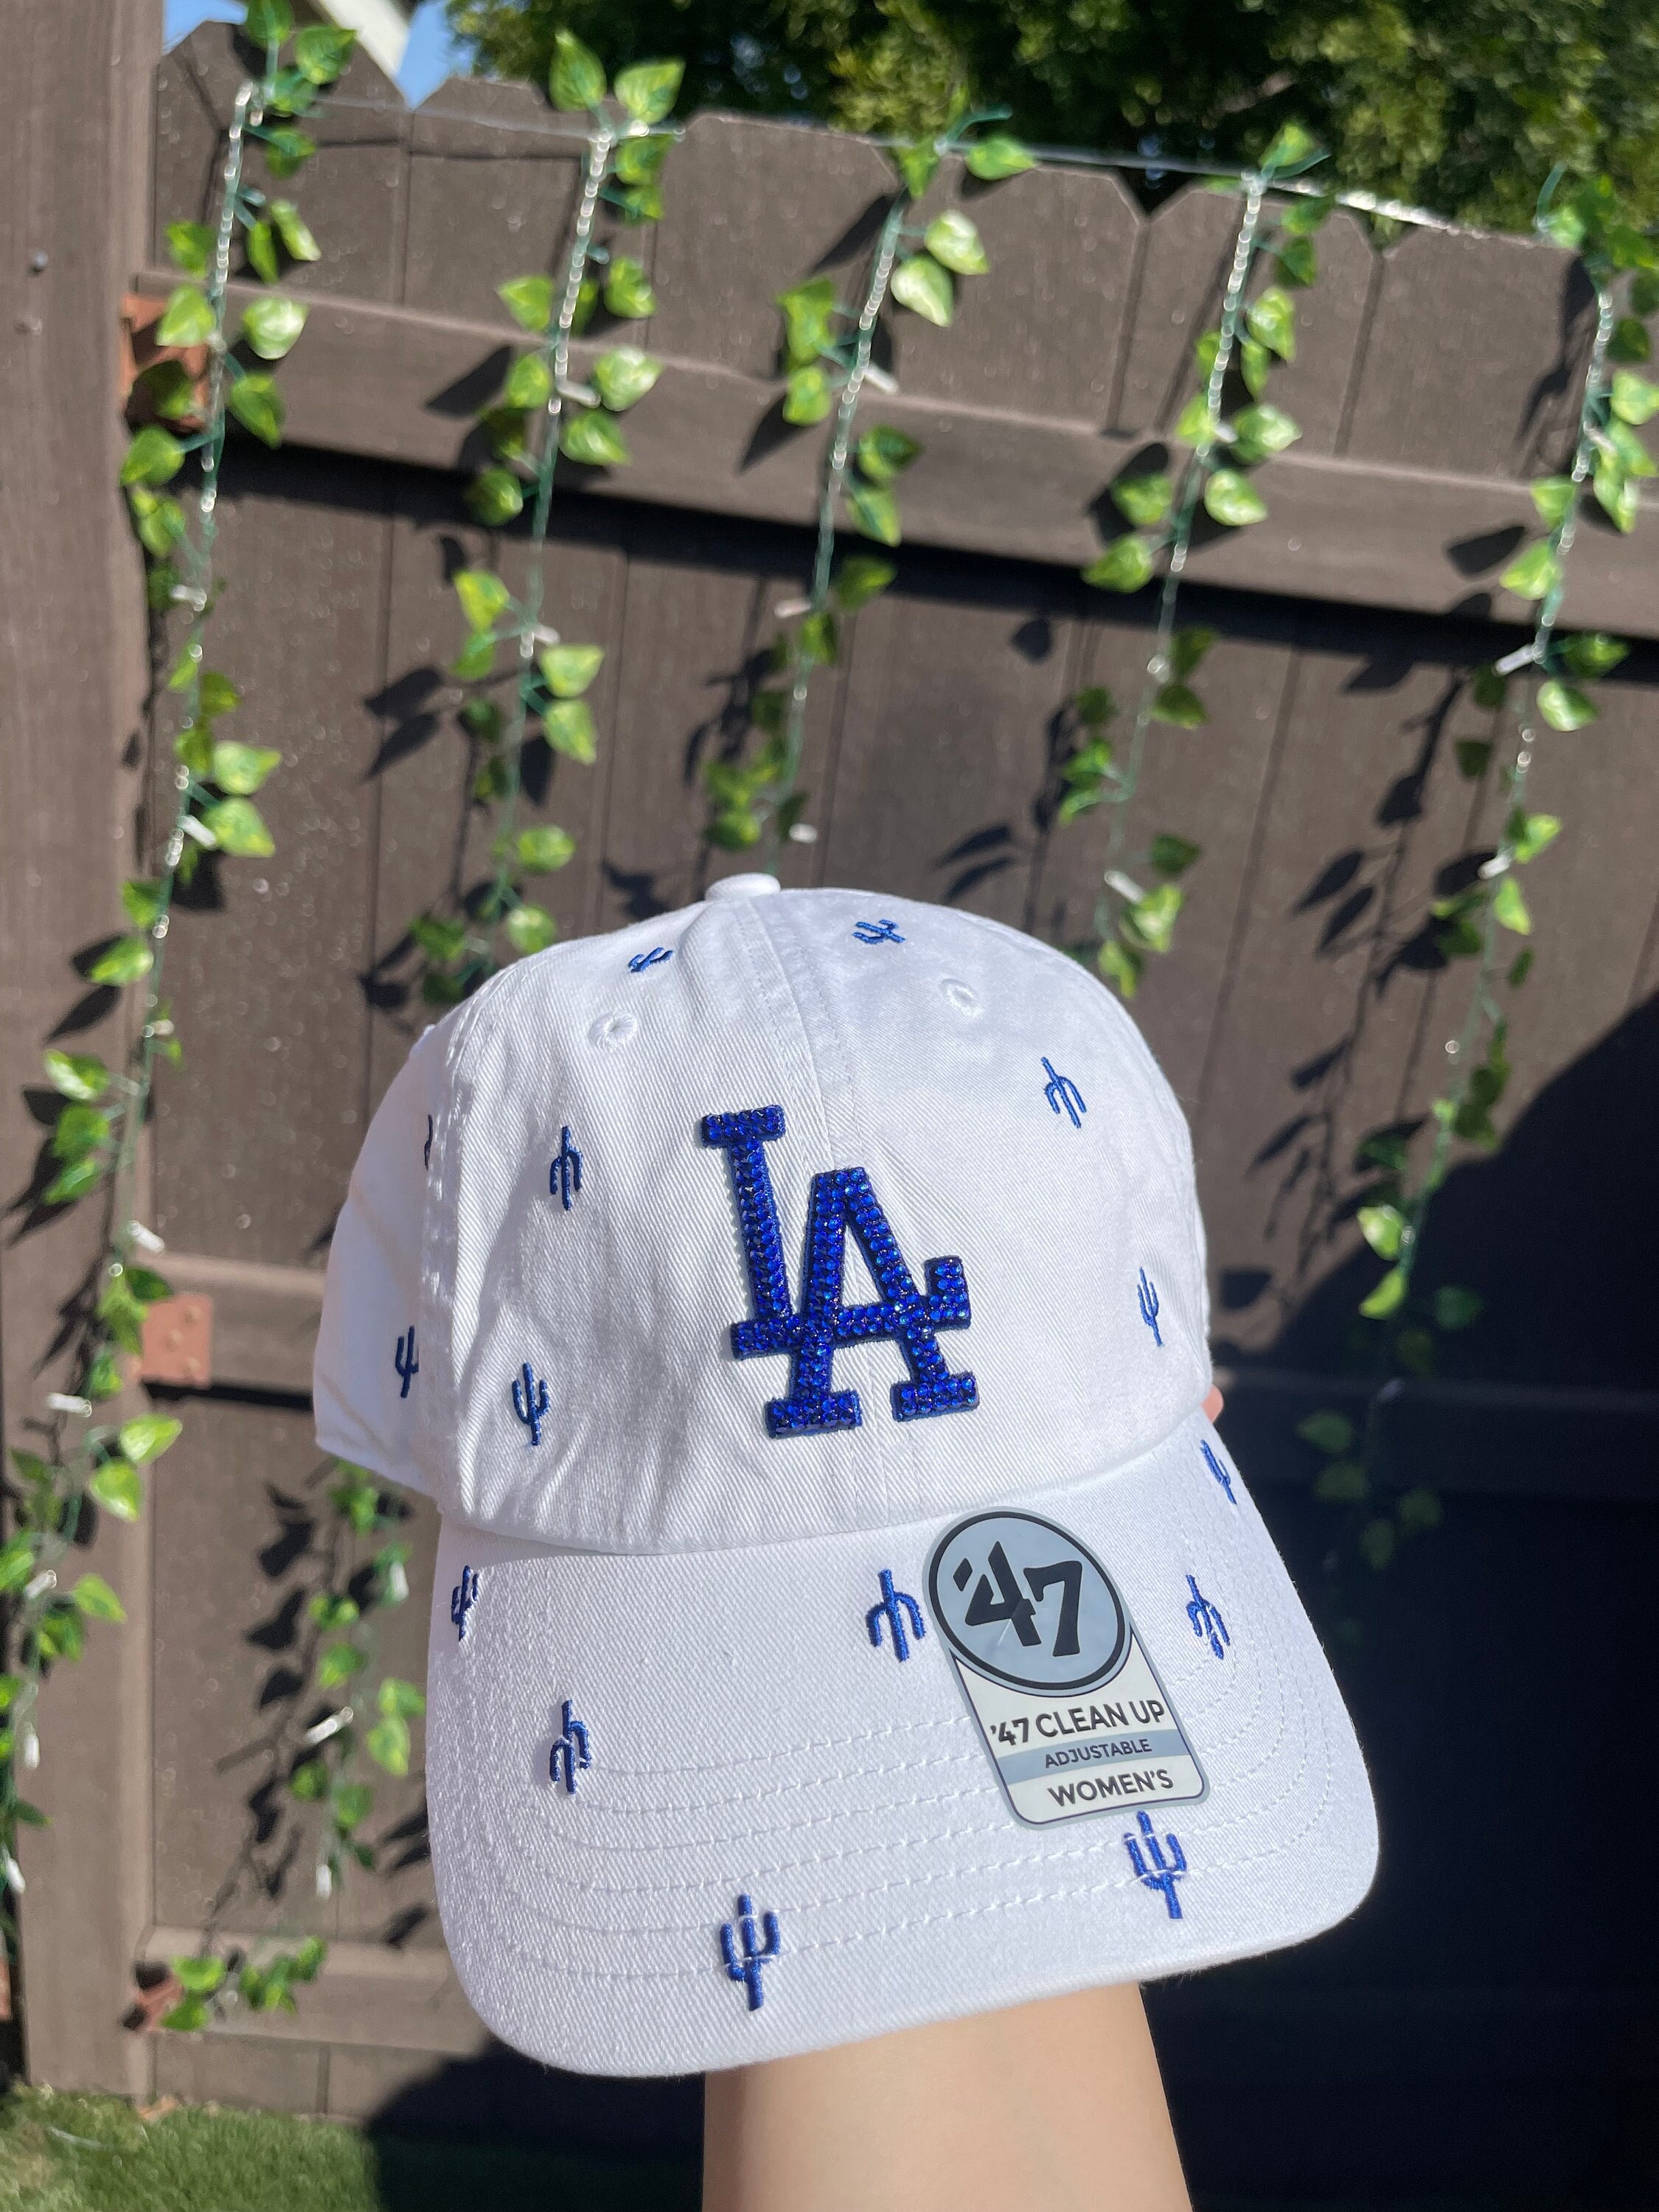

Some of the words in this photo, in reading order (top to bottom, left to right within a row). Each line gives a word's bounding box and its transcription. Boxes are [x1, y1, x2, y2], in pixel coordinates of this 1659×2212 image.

[700, 1105, 980, 1439] LA
[990, 1717, 1029, 1746] '47
[1036, 1702, 1130, 1738] CLEAN
[1130, 1700, 1165, 1726] UP
[1045, 1739, 1152, 1768] ADJUSTABLE
[1048, 1769, 1174, 1806] WOMEN'S
